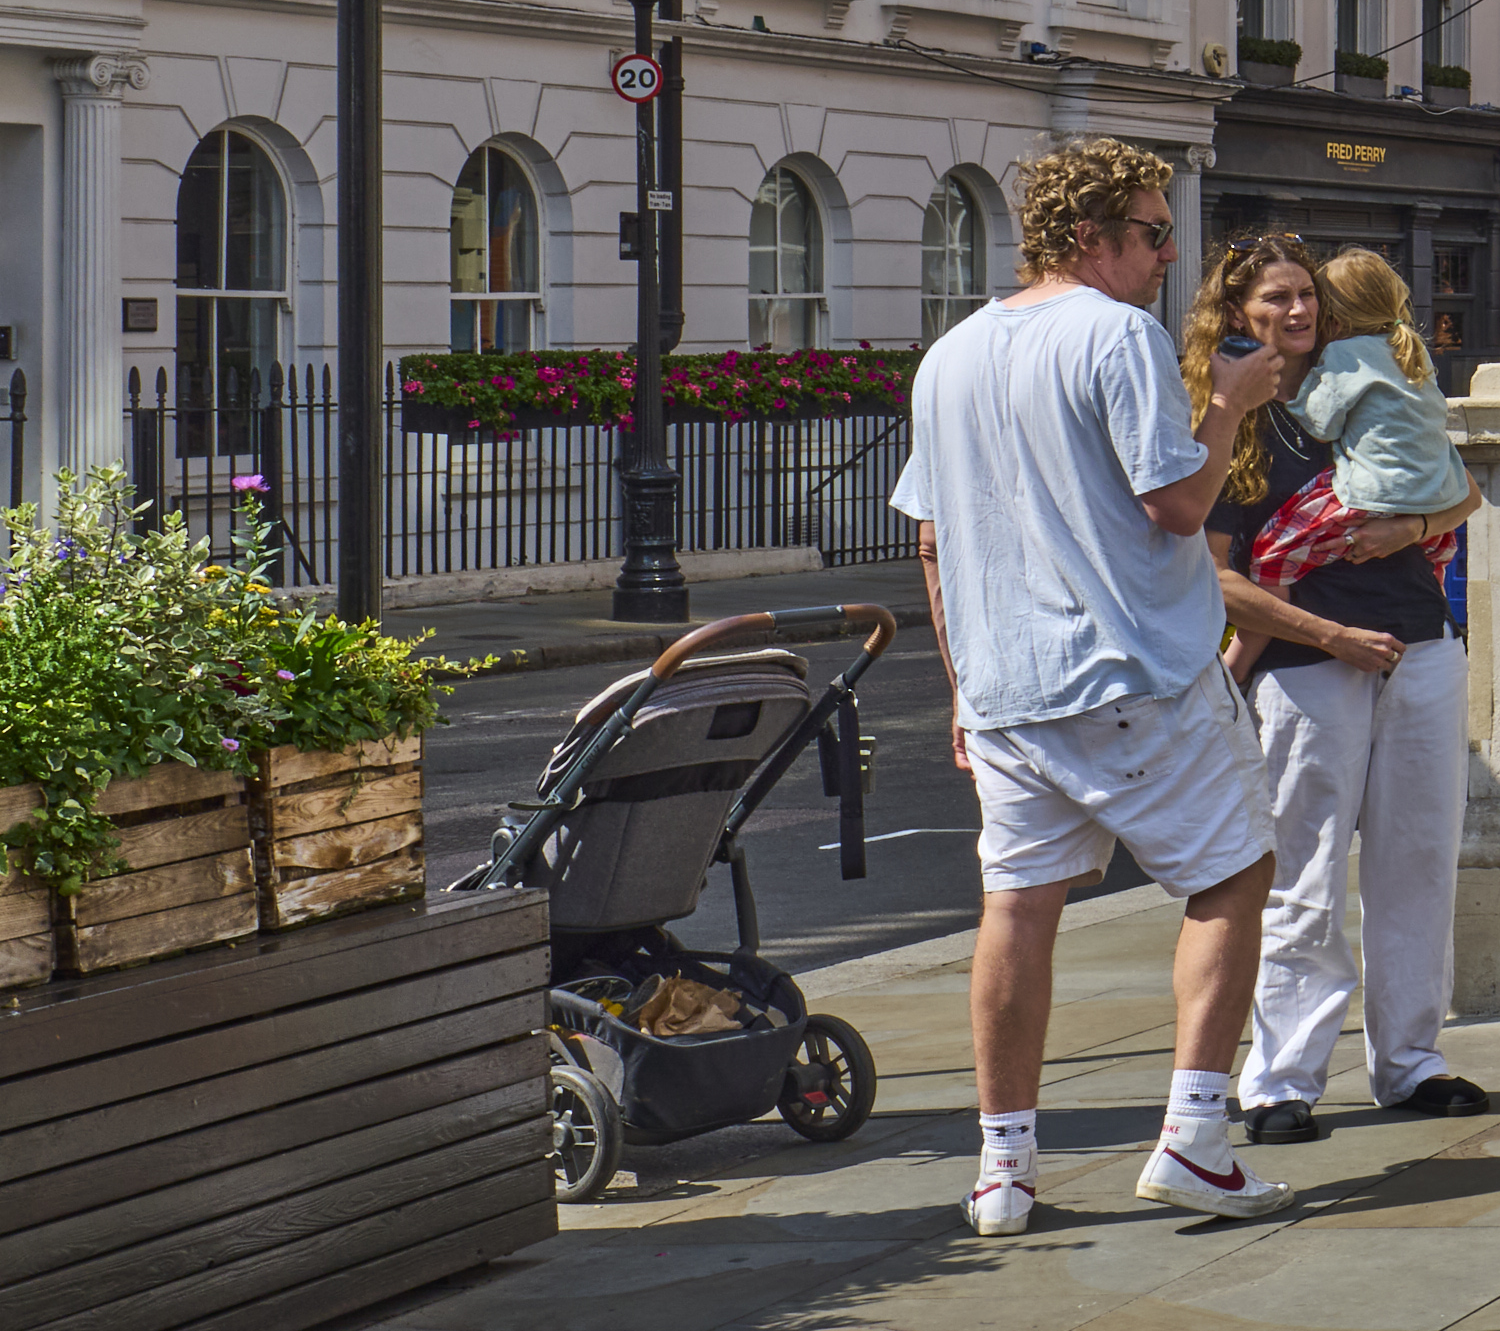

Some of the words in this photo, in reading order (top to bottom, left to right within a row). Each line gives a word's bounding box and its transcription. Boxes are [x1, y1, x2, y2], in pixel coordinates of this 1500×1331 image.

[620, 68, 656, 89] 20
[1326, 142, 1353, 160] FRED
[1354, 144, 1386, 163] PERRY
[996, 1159, 1019, 1168] NIKE
